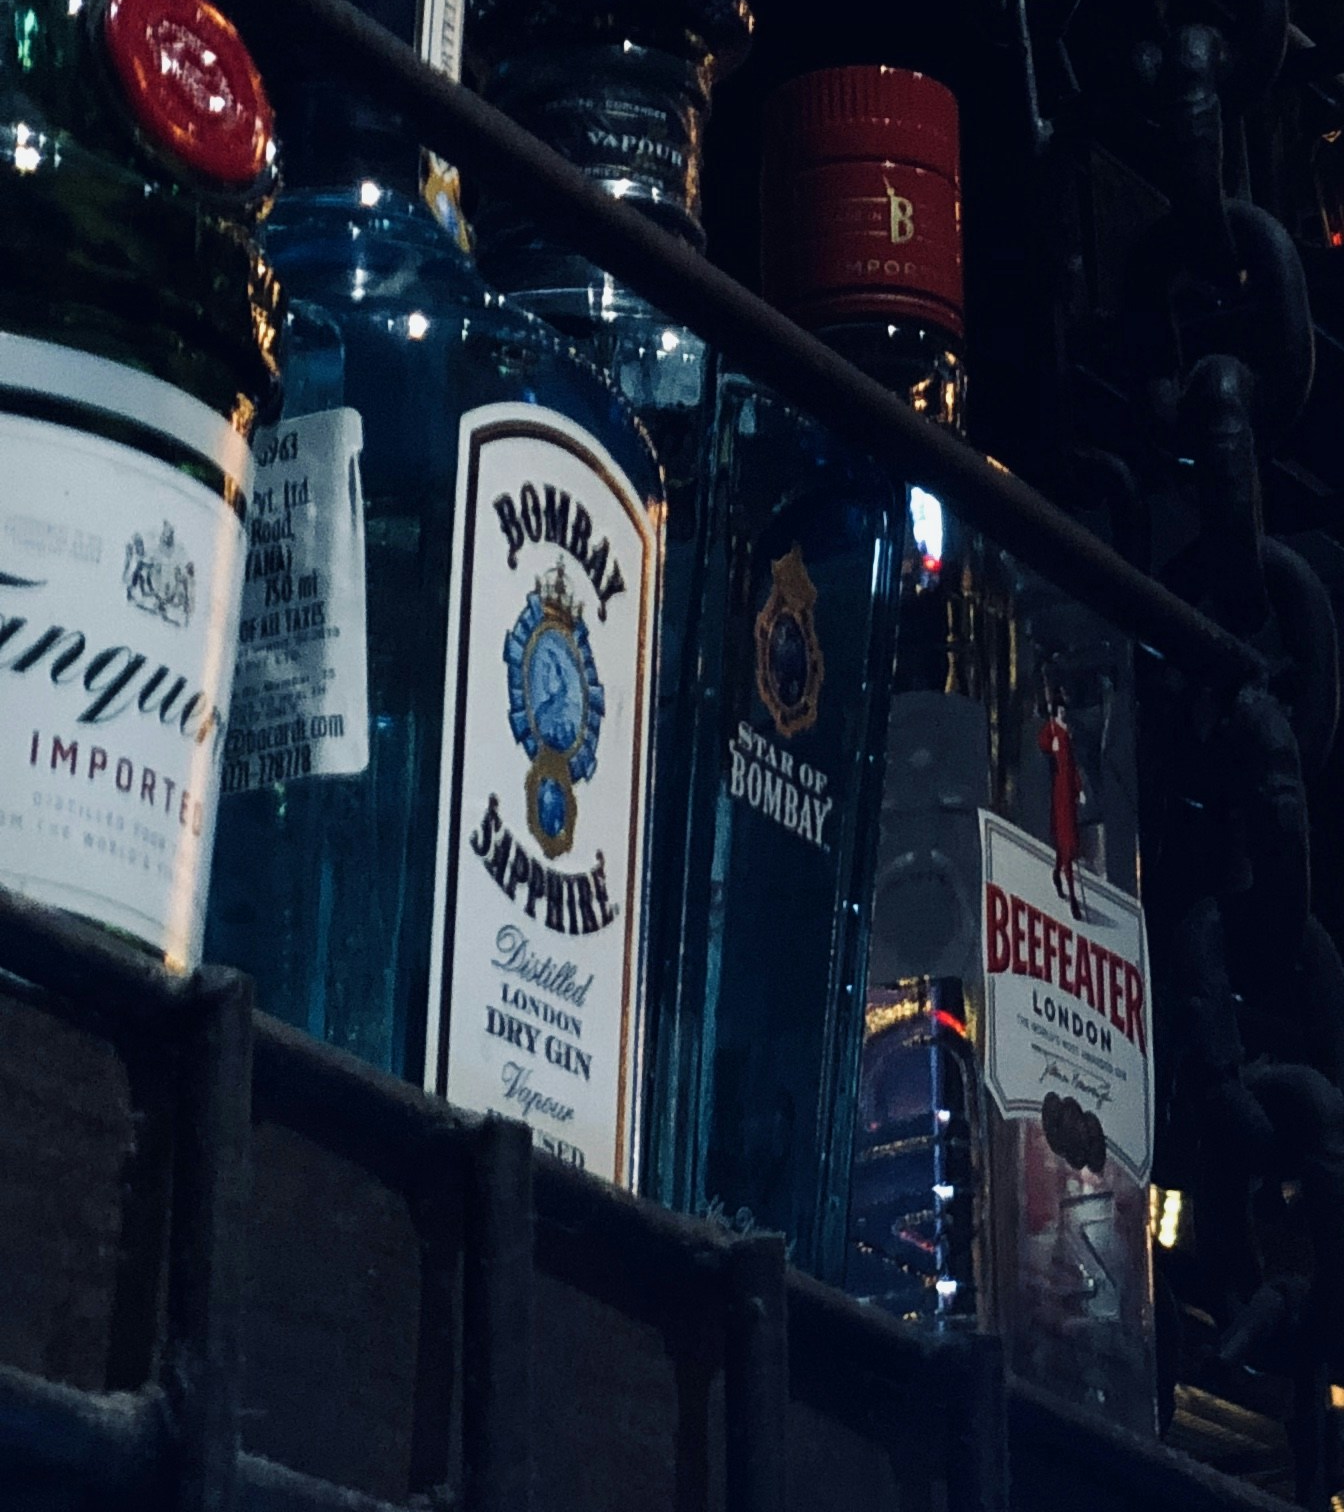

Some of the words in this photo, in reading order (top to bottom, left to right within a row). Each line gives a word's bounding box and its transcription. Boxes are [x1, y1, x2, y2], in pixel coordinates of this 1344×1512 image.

[586, 129, 683, 169] VAPOUR
[493, 480, 627, 623] BOMBAY
[285, 600, 325, 633] TAXES
[30, 729, 204, 838] IMPORTED
[729, 737, 834, 853] BOMBAY
[737, 719, 793, 778] STAR
[799, 768, 829, 795] OF
[469, 791, 617, 936] SAPPHIRE
[491, 924, 595, 1008] Distilled
[986, 882, 1147, 1055] BEEFEATER
[485, 1004, 540, 1056] DRY
[544, 1032, 593, 1082] GIN
[501, 982, 583, 1039] LONDON
[1033, 988, 1112, 1054] LONDON
[501, 1060, 575, 1122] Vapour
